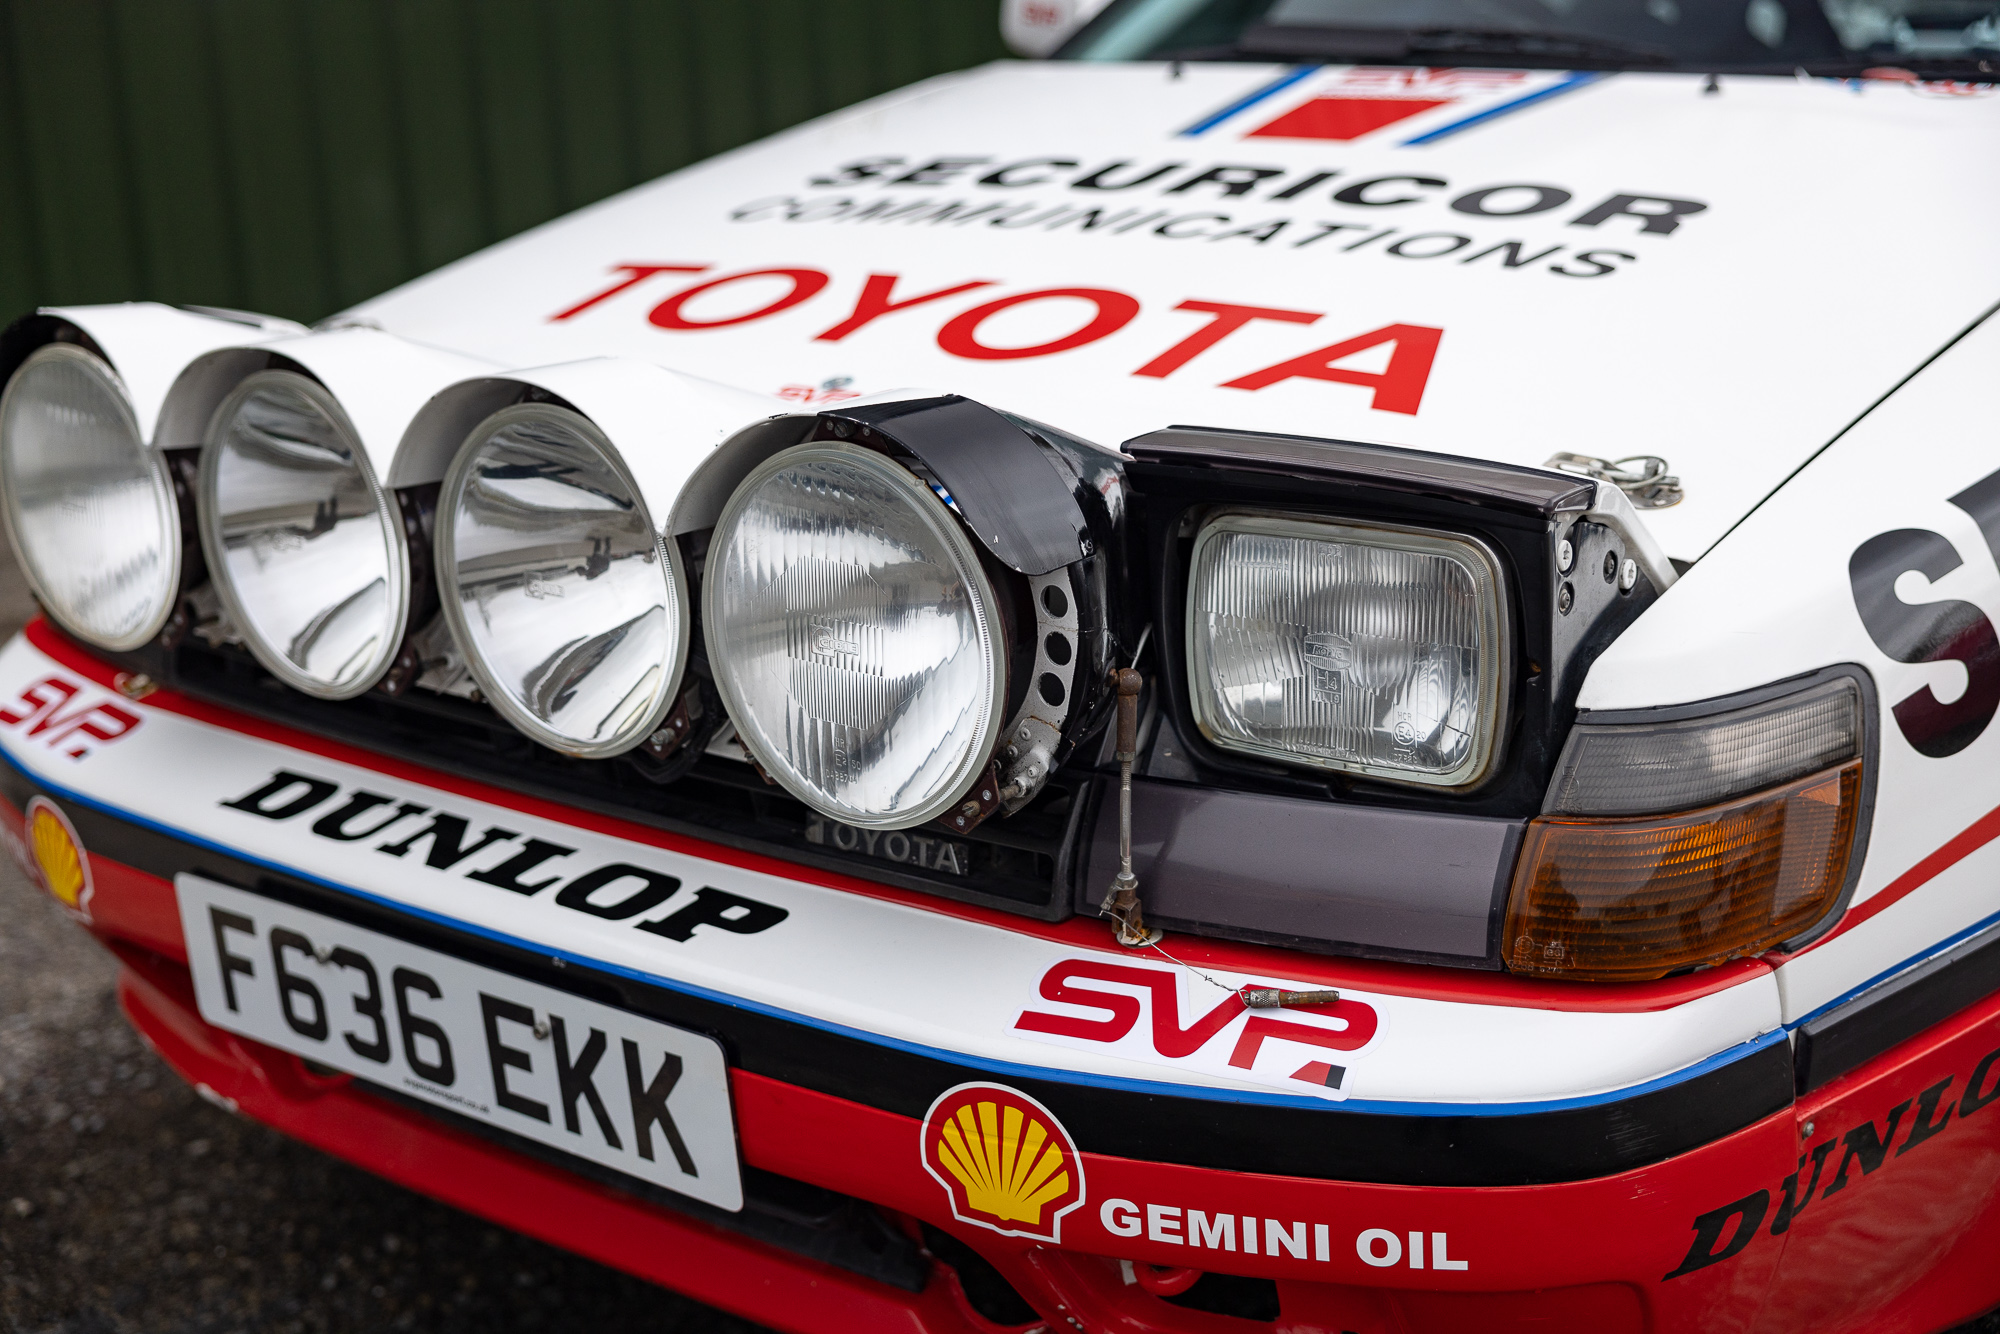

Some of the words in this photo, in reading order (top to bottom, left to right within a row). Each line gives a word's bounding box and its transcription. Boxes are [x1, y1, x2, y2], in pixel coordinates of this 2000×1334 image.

[731, 195, 1638, 278] COMMUNICATIONS
[808, 155, 1709, 237] SECURICOR
[549, 262, 1444, 416] TOYOTA
[220, 769, 790, 943] DUNLOP
[208, 905, 457, 1088] F636
[478, 991, 699, 1180] EKK
[1100, 1198, 1330, 1262] GEMINI
[1356, 1228, 1469, 1271] OIL
